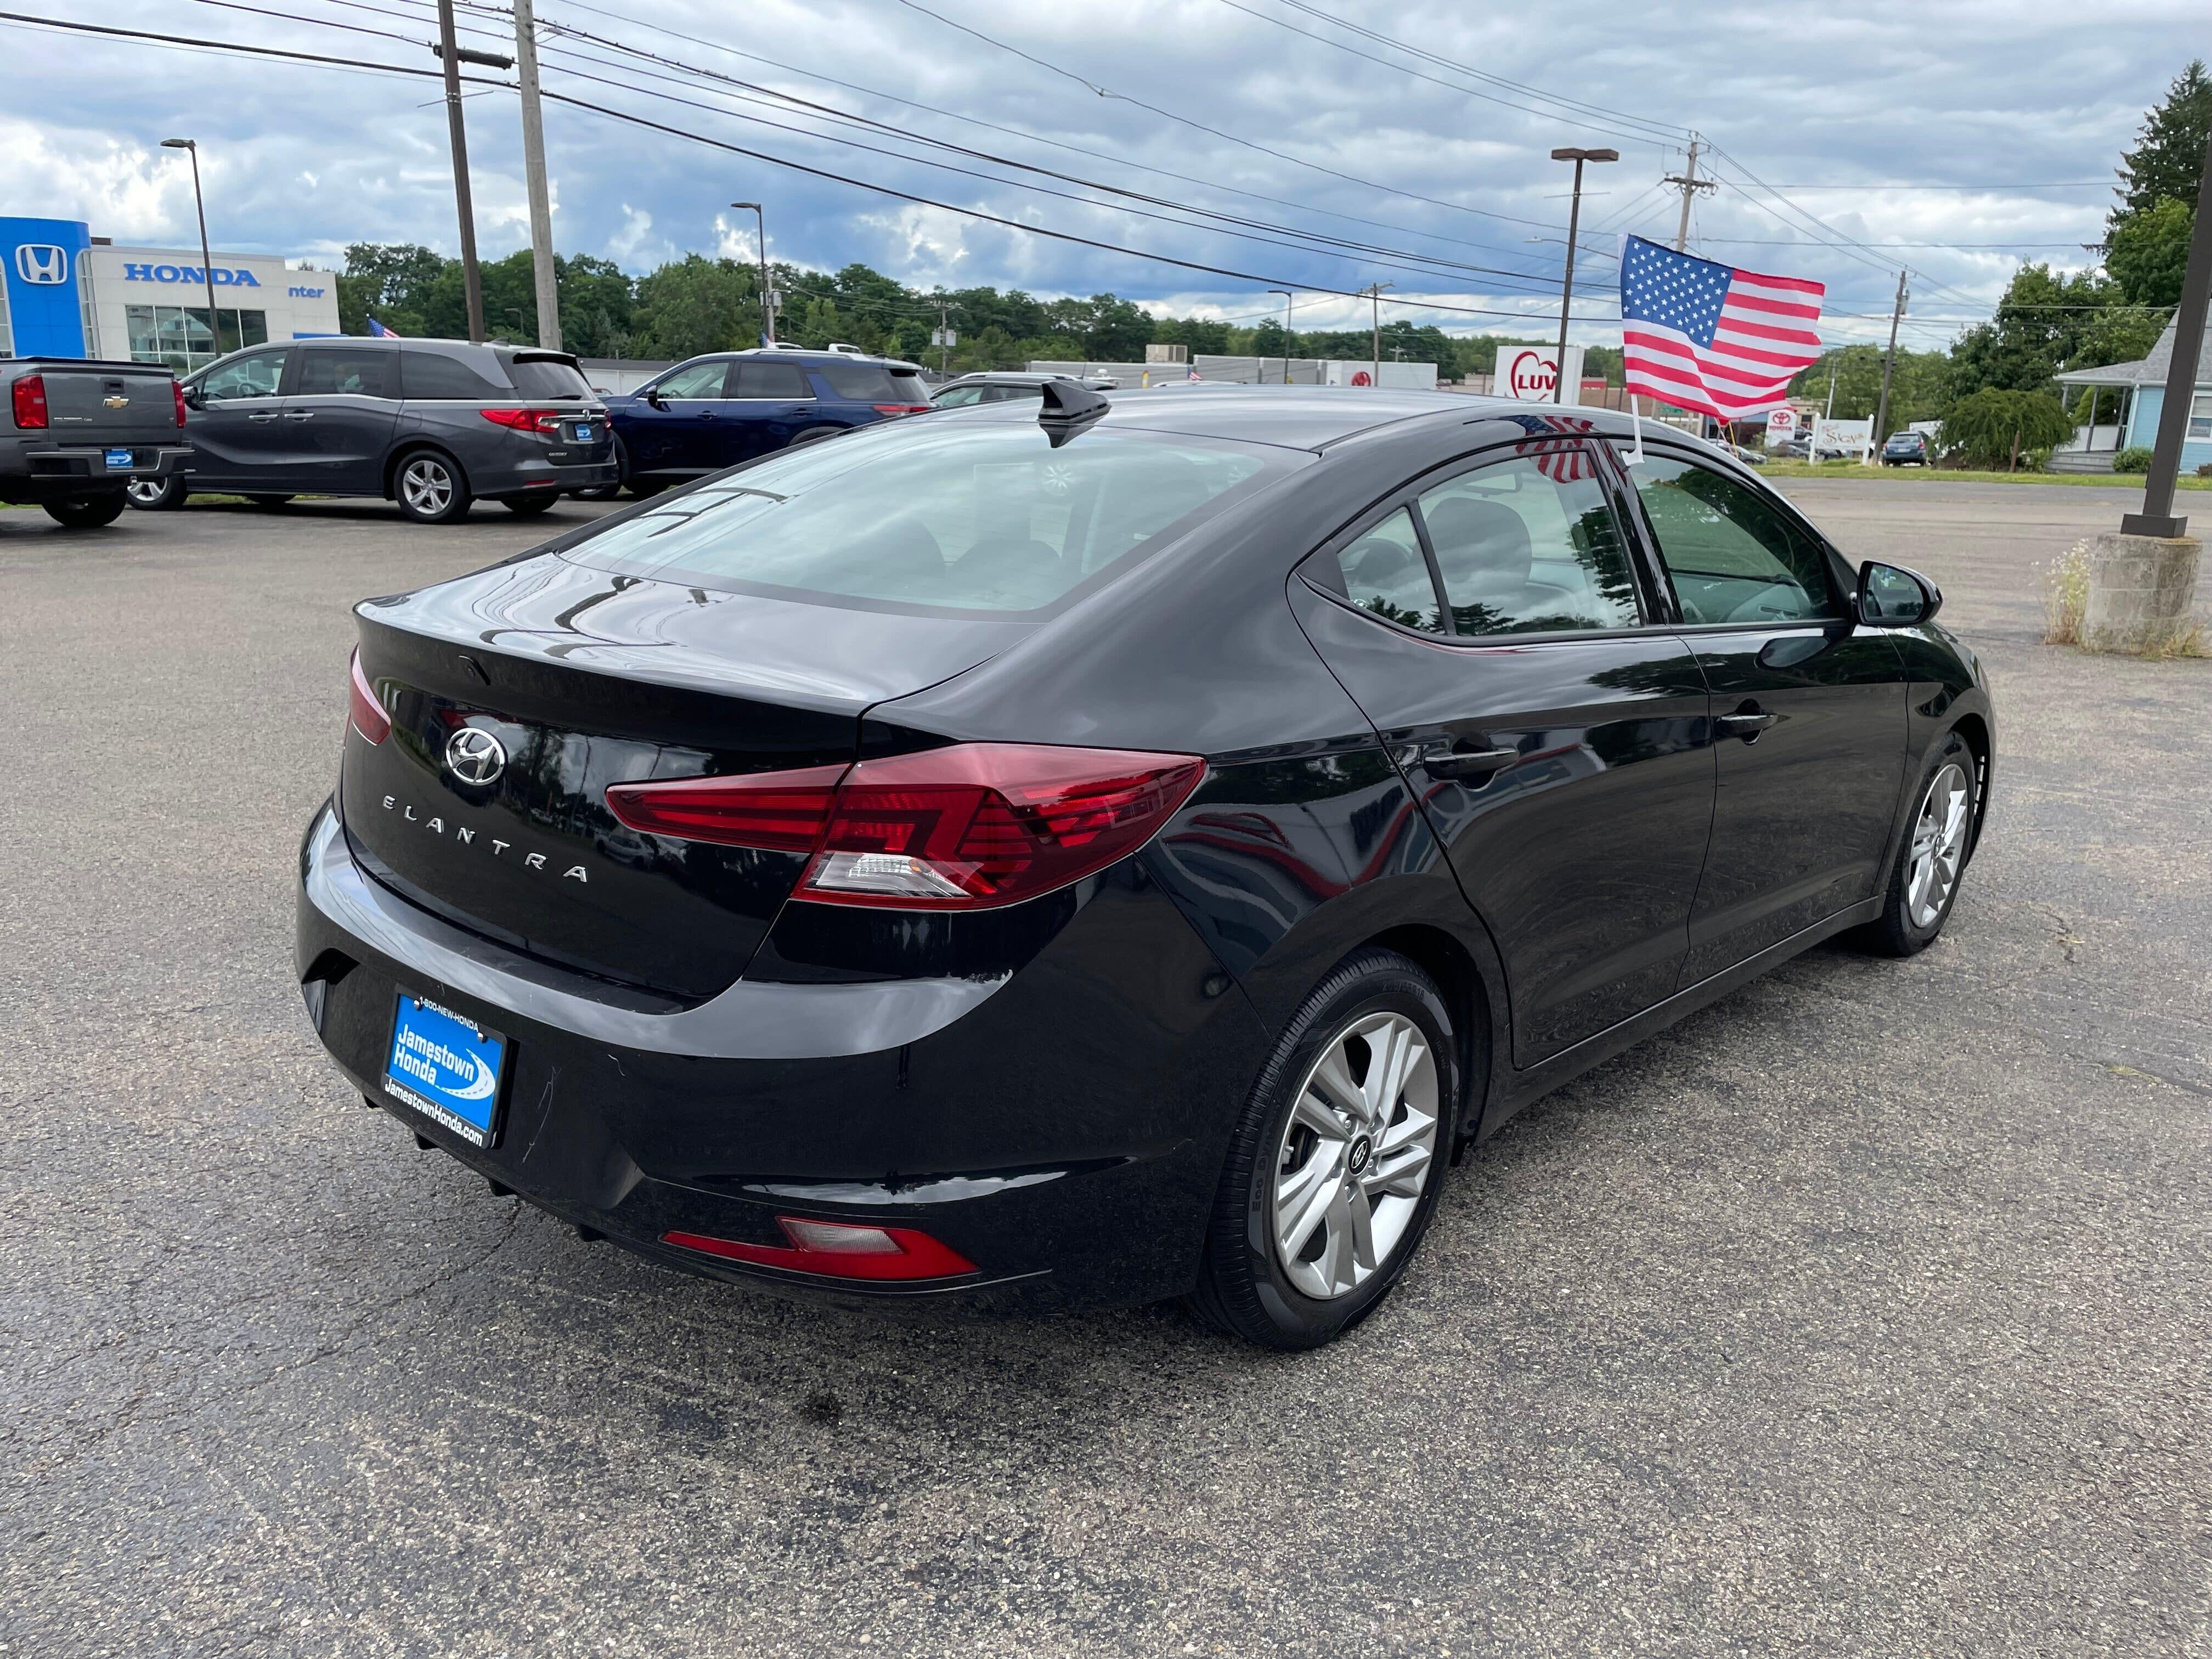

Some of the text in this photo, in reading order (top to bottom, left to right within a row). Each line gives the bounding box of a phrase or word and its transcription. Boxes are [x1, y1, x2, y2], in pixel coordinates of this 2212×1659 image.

[123, 263, 261, 287] HONDA
[288, 285, 325, 298] nter
[1517, 375, 1557, 390] LUV
[382, 795, 588, 883] ELANTRA
[419, 996, 479, 1032] 1-800-NEW-HONDA
[393, 1043, 438, 1086] Honda
[397, 1023, 475, 1082] Jamestown
[385, 1078, 483, 1147] JamestownHonda.com
